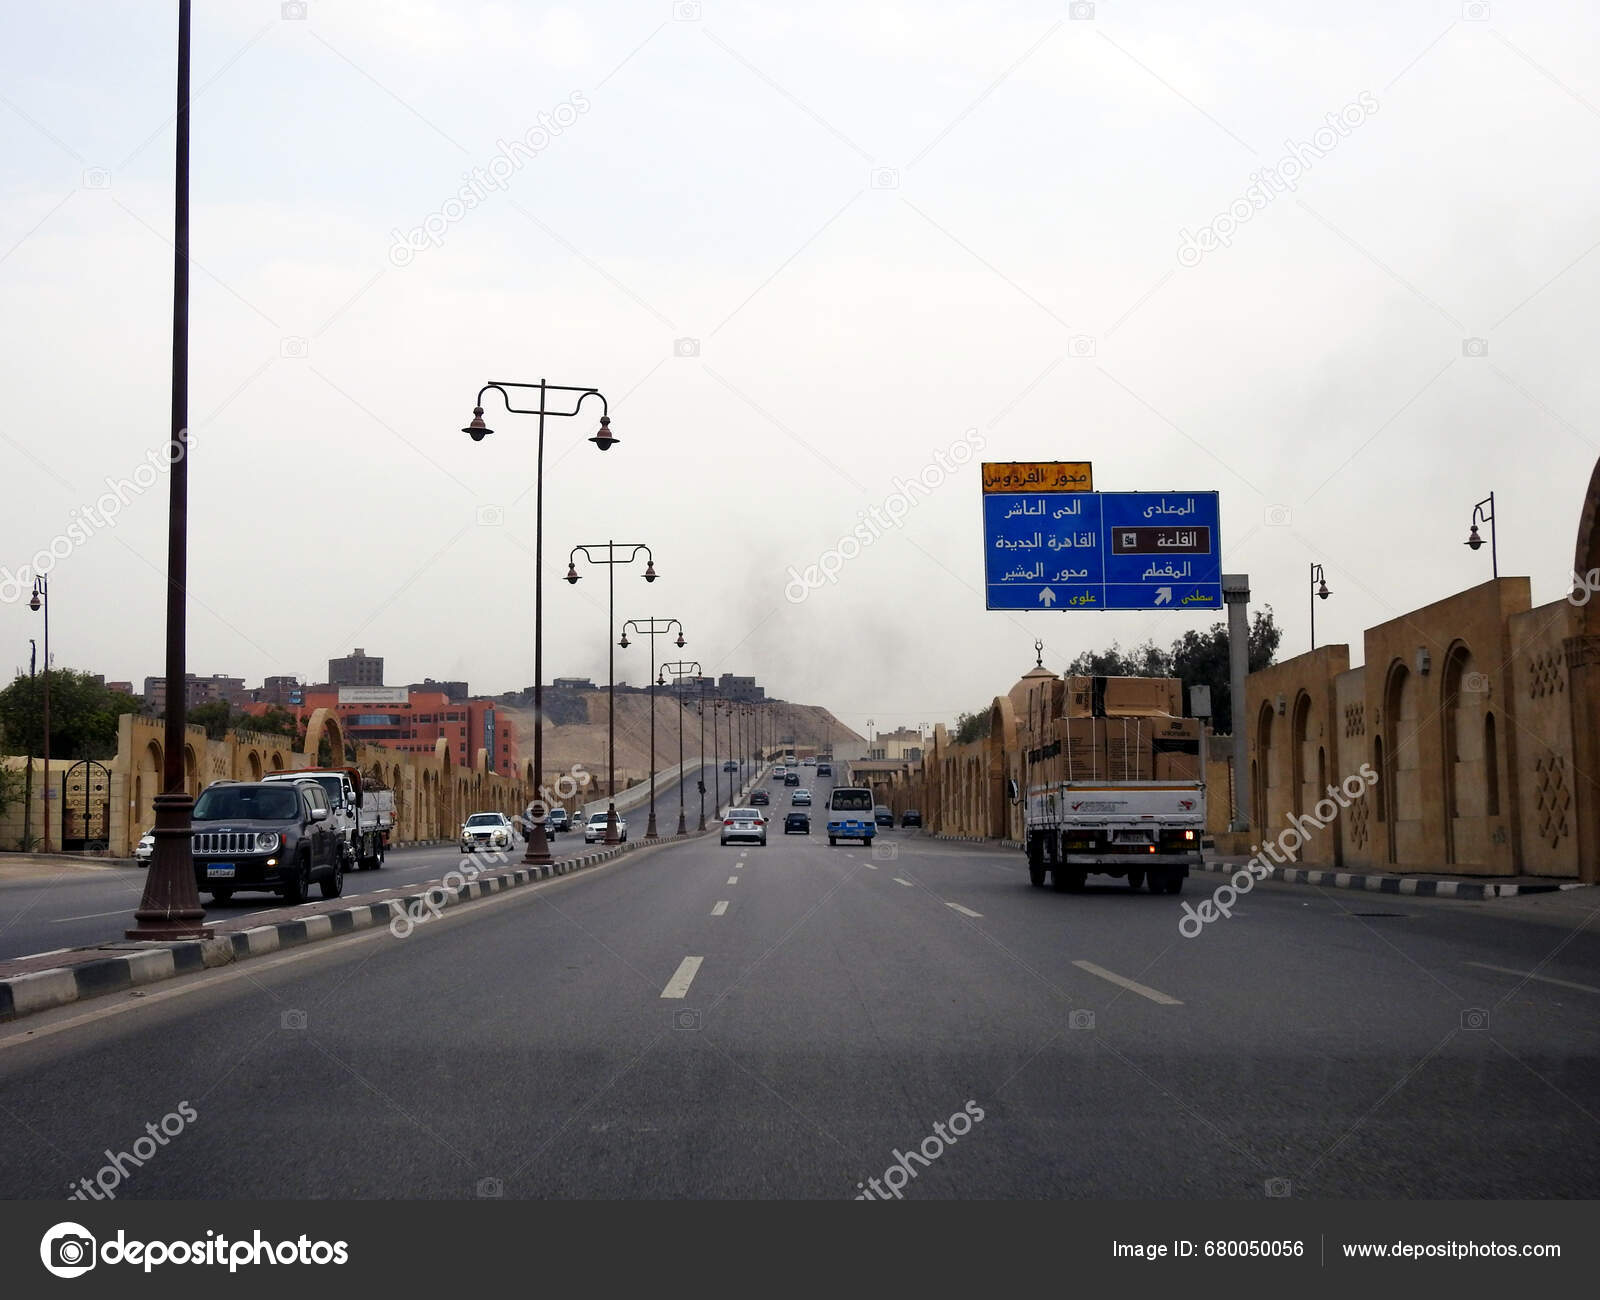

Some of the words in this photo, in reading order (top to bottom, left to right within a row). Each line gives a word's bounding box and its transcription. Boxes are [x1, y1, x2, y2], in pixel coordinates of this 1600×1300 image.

[1051, 473, 1087, 487] محور
[1004, 499, 1046, 518] العاشر
[995, 532, 1042, 552] الجديدة
[1047, 532, 1096, 551] القاهرة
[1157, 531, 1197, 547] القلعة
[1001, 562, 1044, 581] المشير
[1052, 568, 1088, 581] محور
[1142, 561, 1191, 580] المقطم
